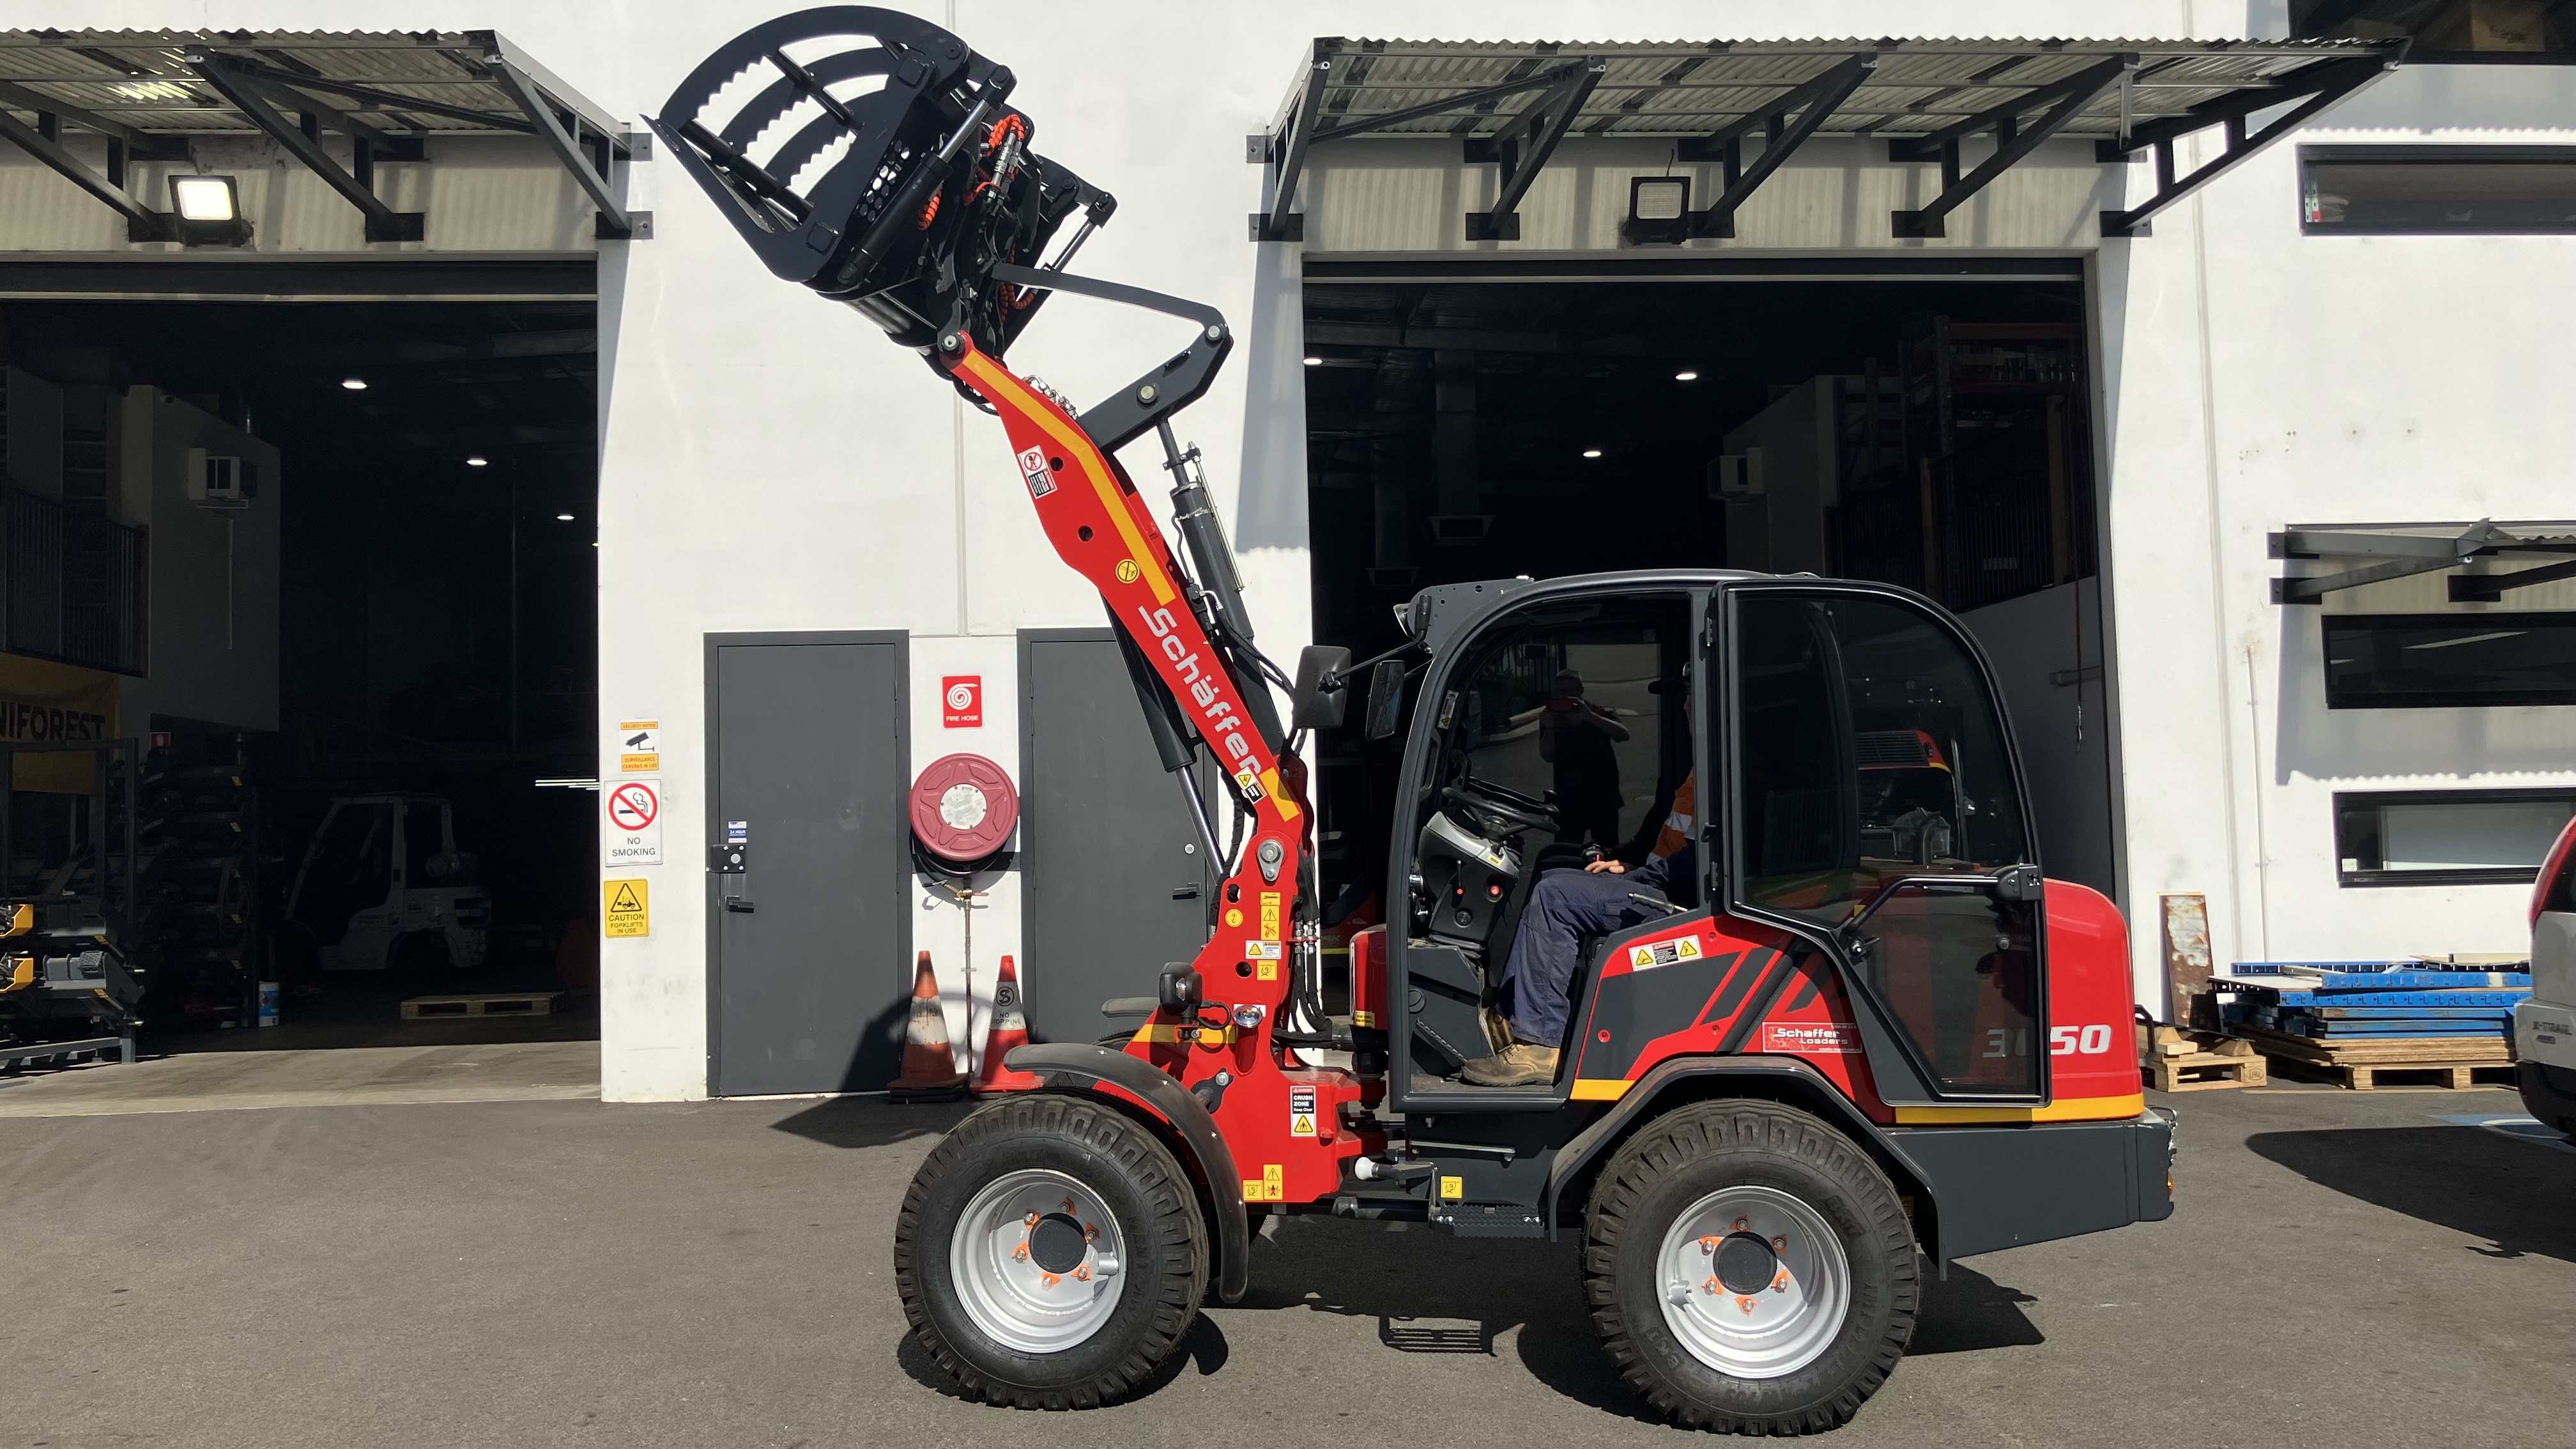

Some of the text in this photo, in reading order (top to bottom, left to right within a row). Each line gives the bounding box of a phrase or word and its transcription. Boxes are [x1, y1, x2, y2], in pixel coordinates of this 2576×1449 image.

[1137, 606, 1261, 775] Schäffer
[612, 848, 656, 857] SMOKING
[1773, 1028, 1840, 1038] Schaffer
[1644, 1329, 1681, 1368] BKT
